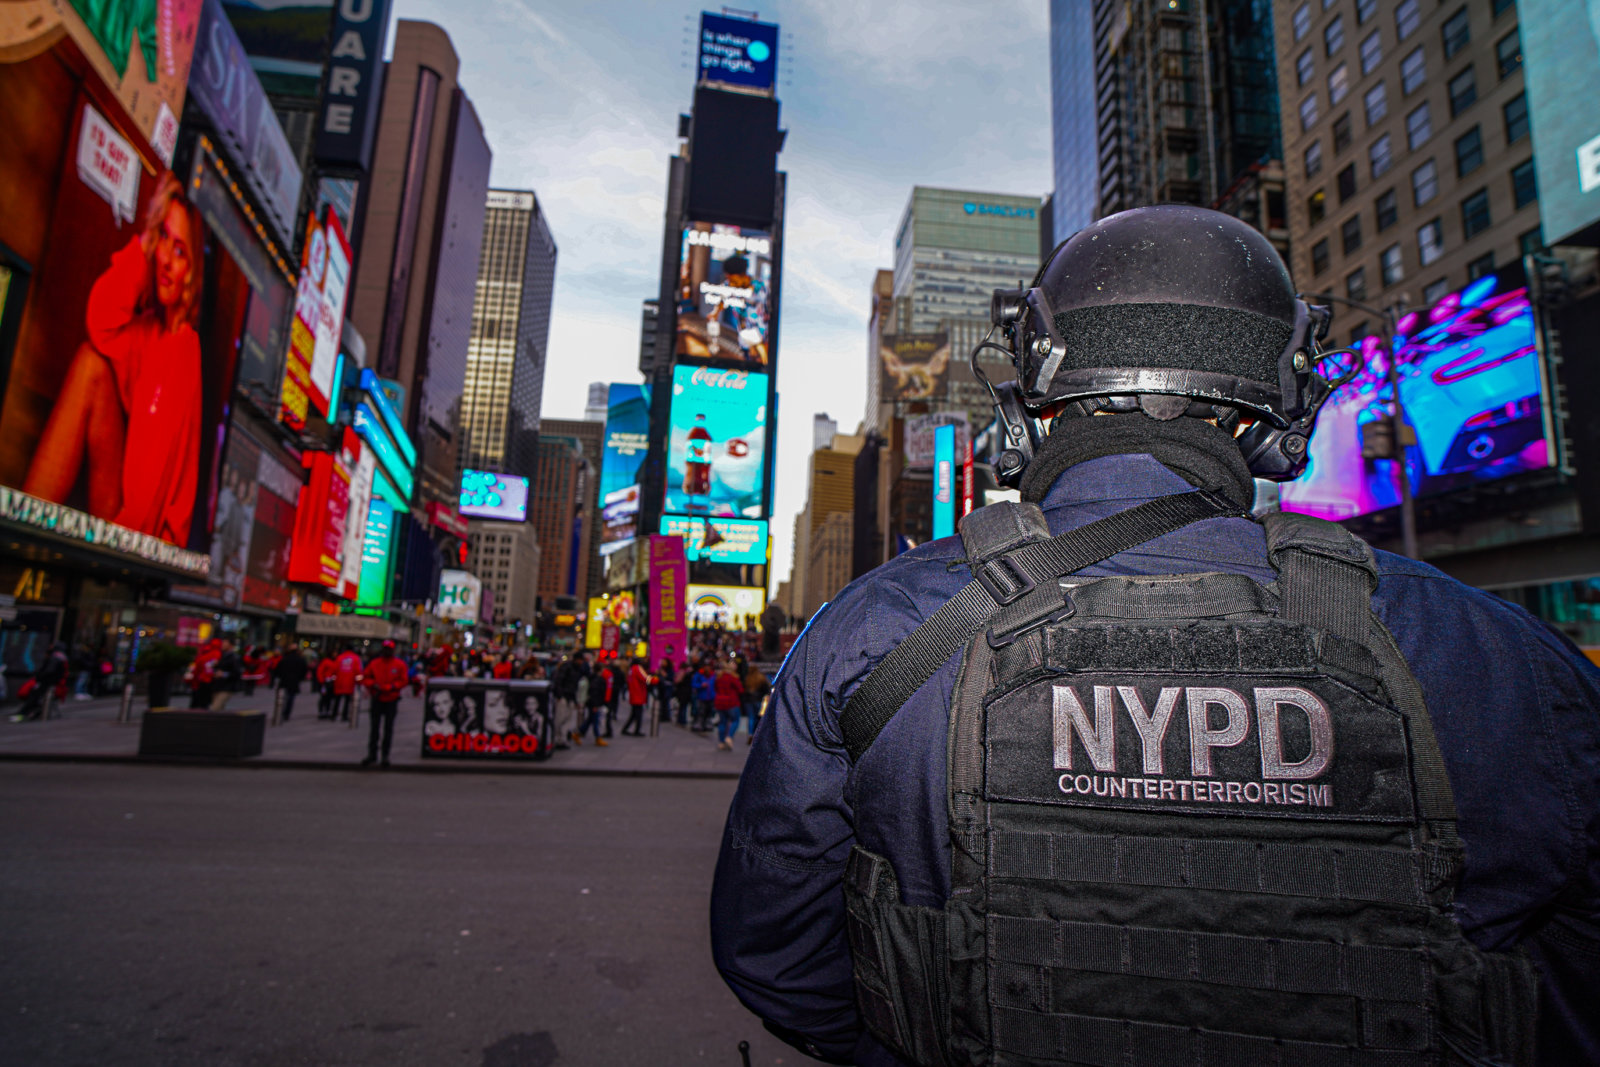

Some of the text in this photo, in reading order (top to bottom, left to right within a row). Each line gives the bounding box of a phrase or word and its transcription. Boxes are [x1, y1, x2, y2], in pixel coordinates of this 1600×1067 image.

[977, 203, 1036, 220] BARCLAYS
[428, 732, 539, 755] CHICAGO
[1051, 684, 1335, 780] NYPD
[1058, 773, 1335, 808] COUNTERTERRORISM
